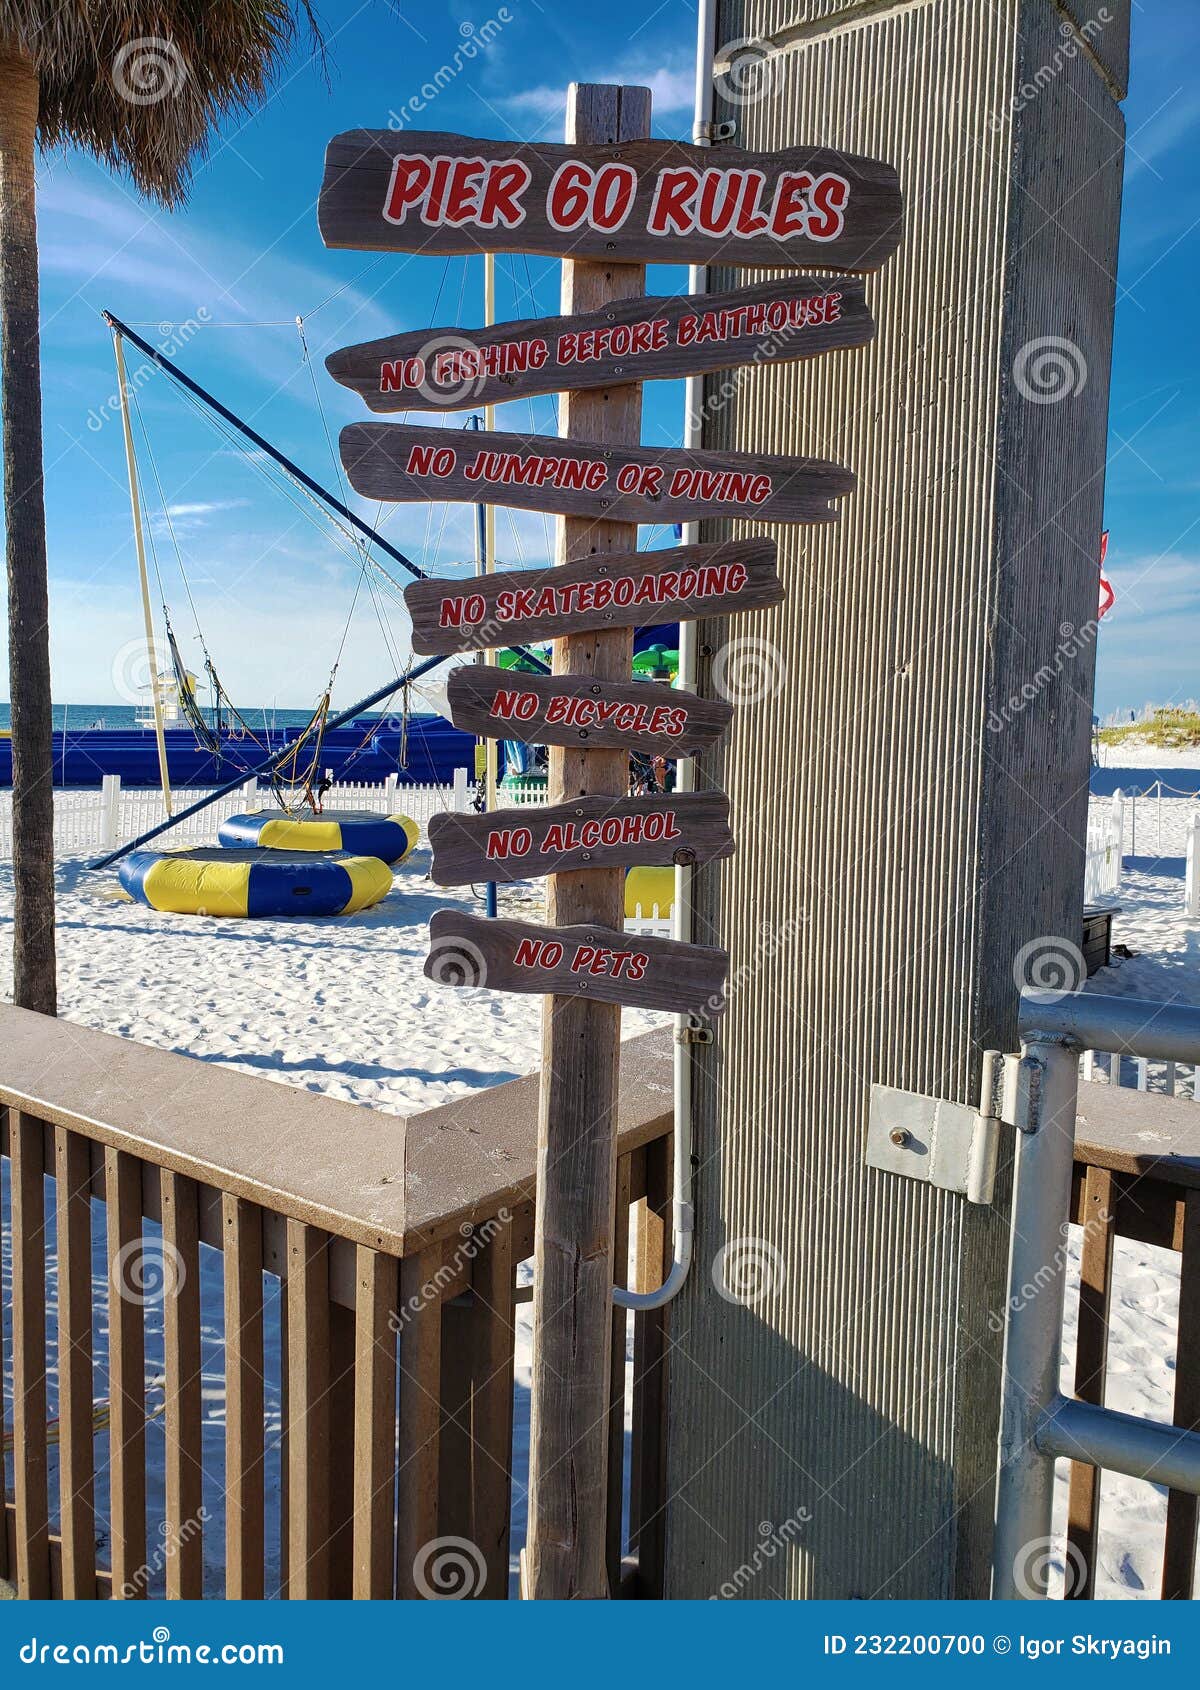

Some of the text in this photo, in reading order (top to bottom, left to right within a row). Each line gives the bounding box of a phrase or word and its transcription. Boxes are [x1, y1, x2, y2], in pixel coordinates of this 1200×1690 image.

[383, 153, 850, 241] PIER 60 RULES
[380, 292, 841, 392] NO FISHING BEFORE BAITHOUSE
[406, 446, 772, 505] NO JUMPING OR DIVING
[439, 563, 748, 628] NO SKATEBOARDING
[490, 689, 688, 736] NO BICYCLES
[486, 811, 681, 859] NO ALCOHOL
[513, 939, 649, 980] NO PETS
